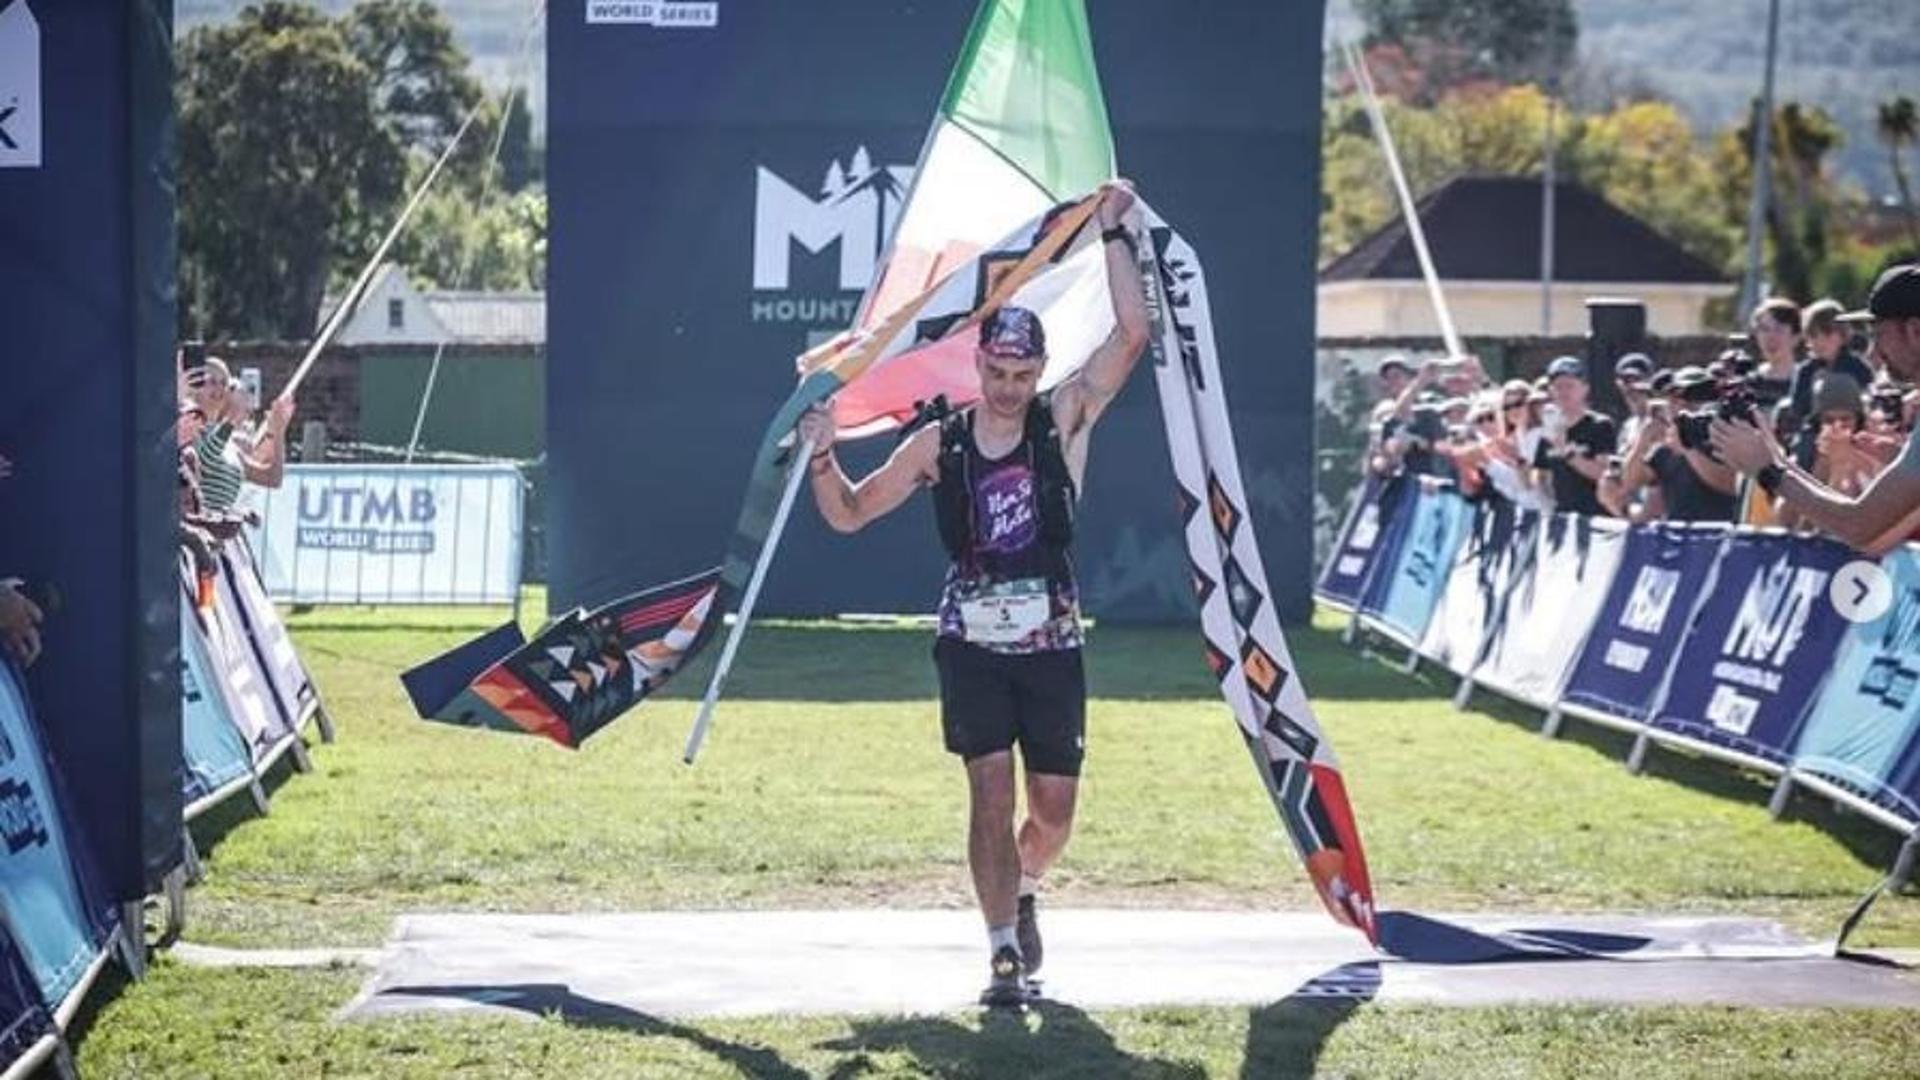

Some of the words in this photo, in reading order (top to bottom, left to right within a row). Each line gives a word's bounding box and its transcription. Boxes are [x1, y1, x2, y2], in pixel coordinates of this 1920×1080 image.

[591, 4, 653, 19] WORLD
[660, 7, 712, 21] SERIES
[752, 298, 857, 321] MOUNT
[298, 486, 437, 523] UTMB
[302, 530, 368, 547] WORLD
